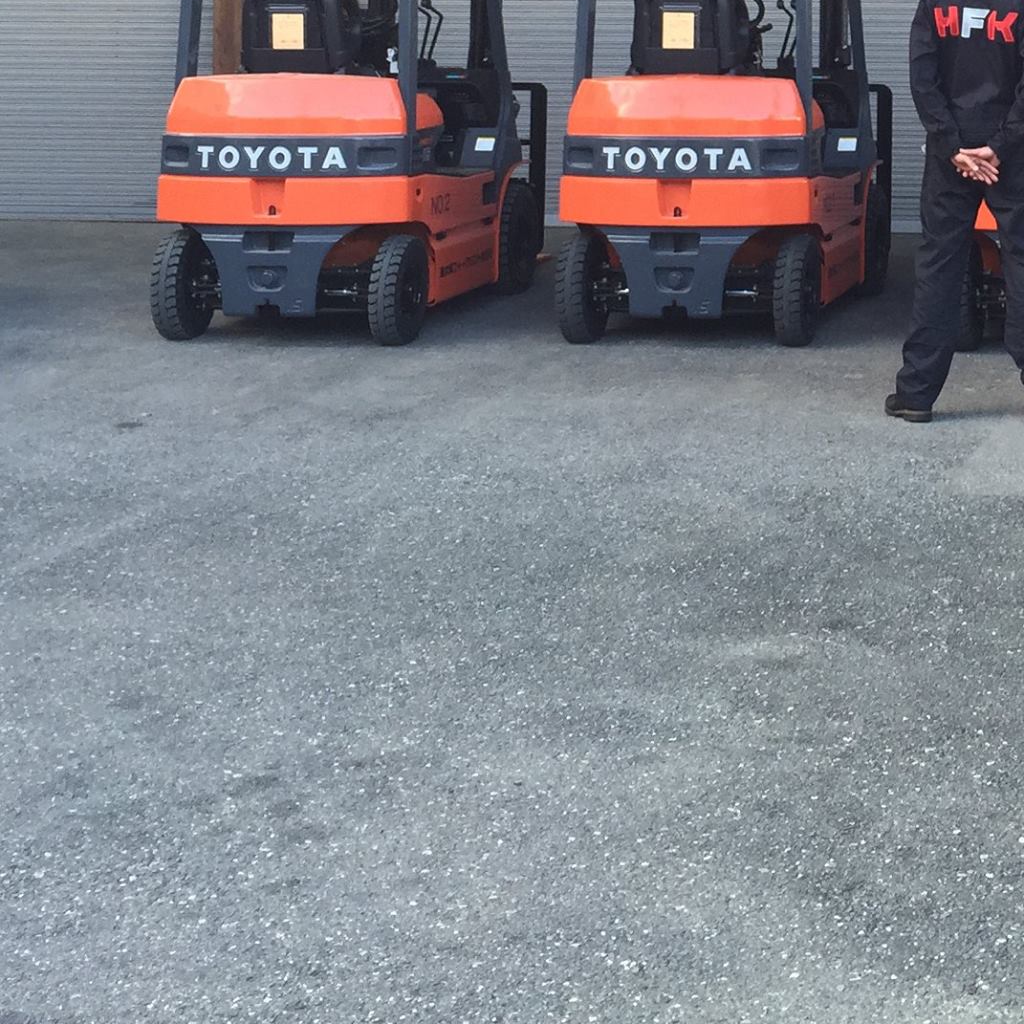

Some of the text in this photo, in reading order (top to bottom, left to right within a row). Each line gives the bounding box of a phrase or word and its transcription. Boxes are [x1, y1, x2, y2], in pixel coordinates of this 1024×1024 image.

[934, 6, 1020, 43] HFK
[197, 145, 348, 171] TOYOTA
[602, 146, 752, 172] TOYOTA
